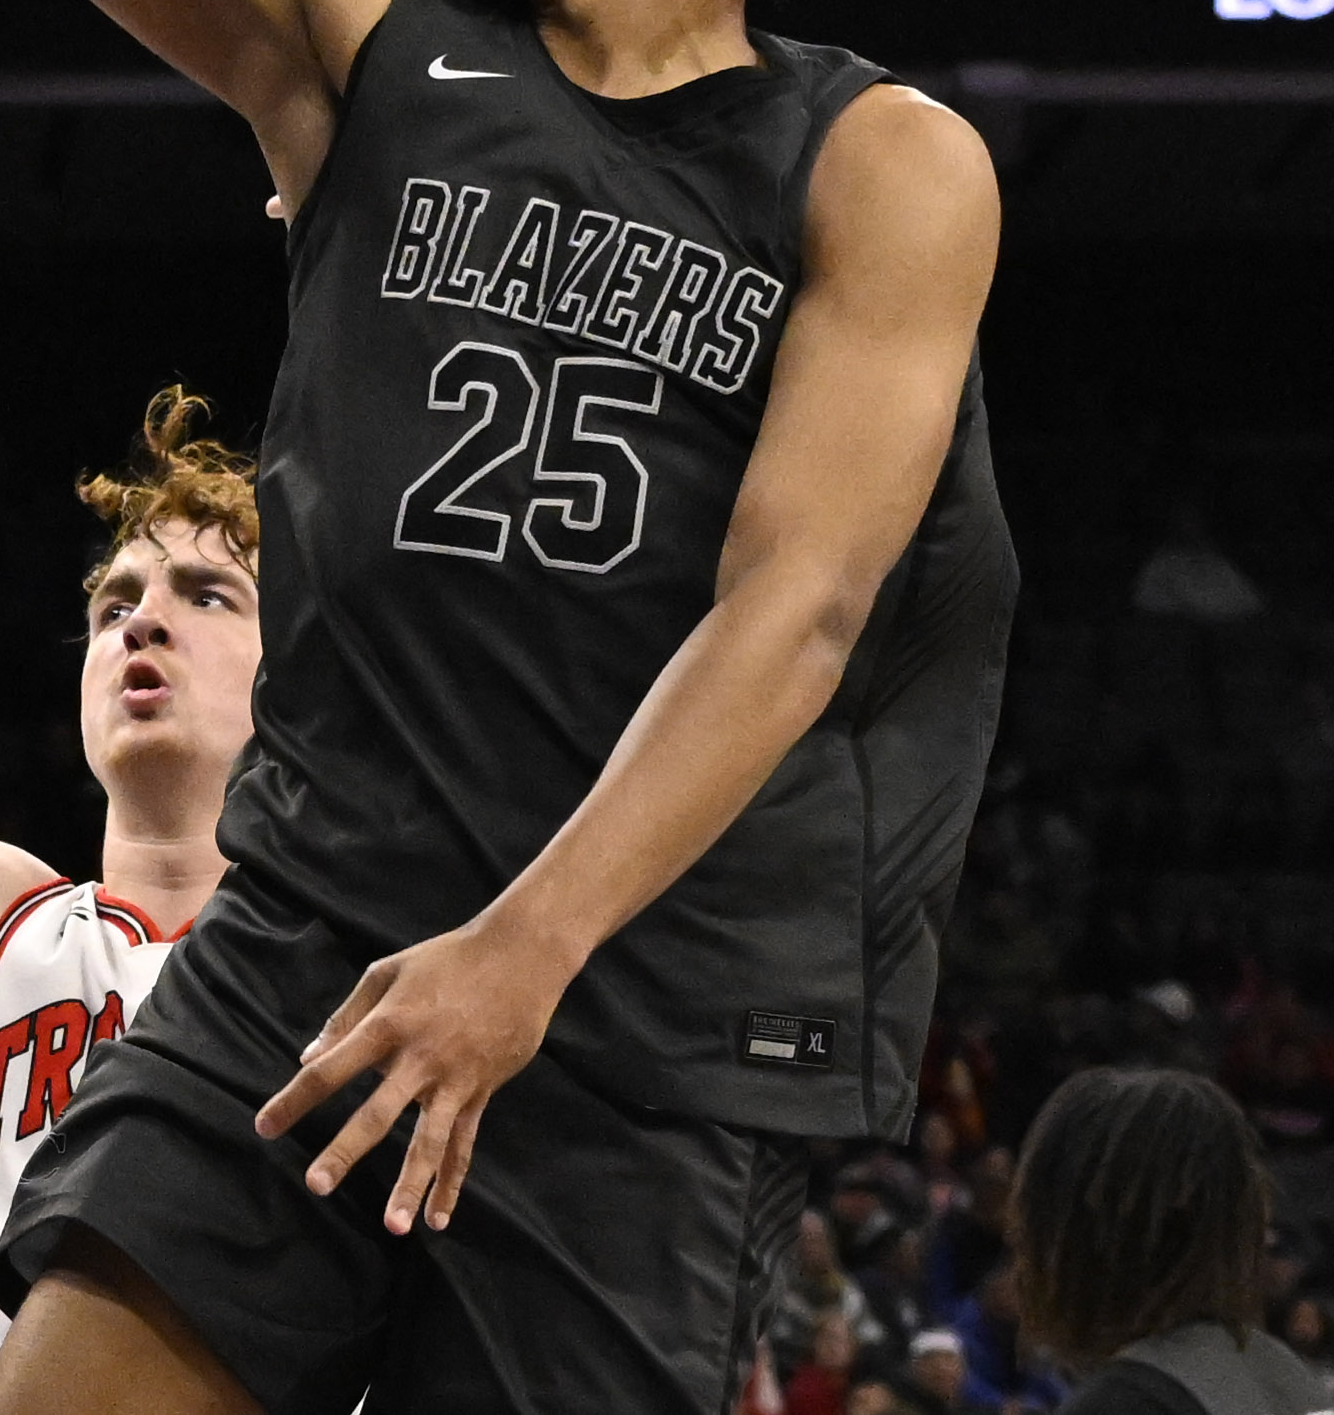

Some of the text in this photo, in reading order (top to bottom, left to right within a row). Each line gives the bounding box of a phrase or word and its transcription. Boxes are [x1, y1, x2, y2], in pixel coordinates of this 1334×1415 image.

[380, 177, 785, 396] BLAZERS
[392, 340, 665, 575] 25
[806, 1031, 827, 1055] XL
